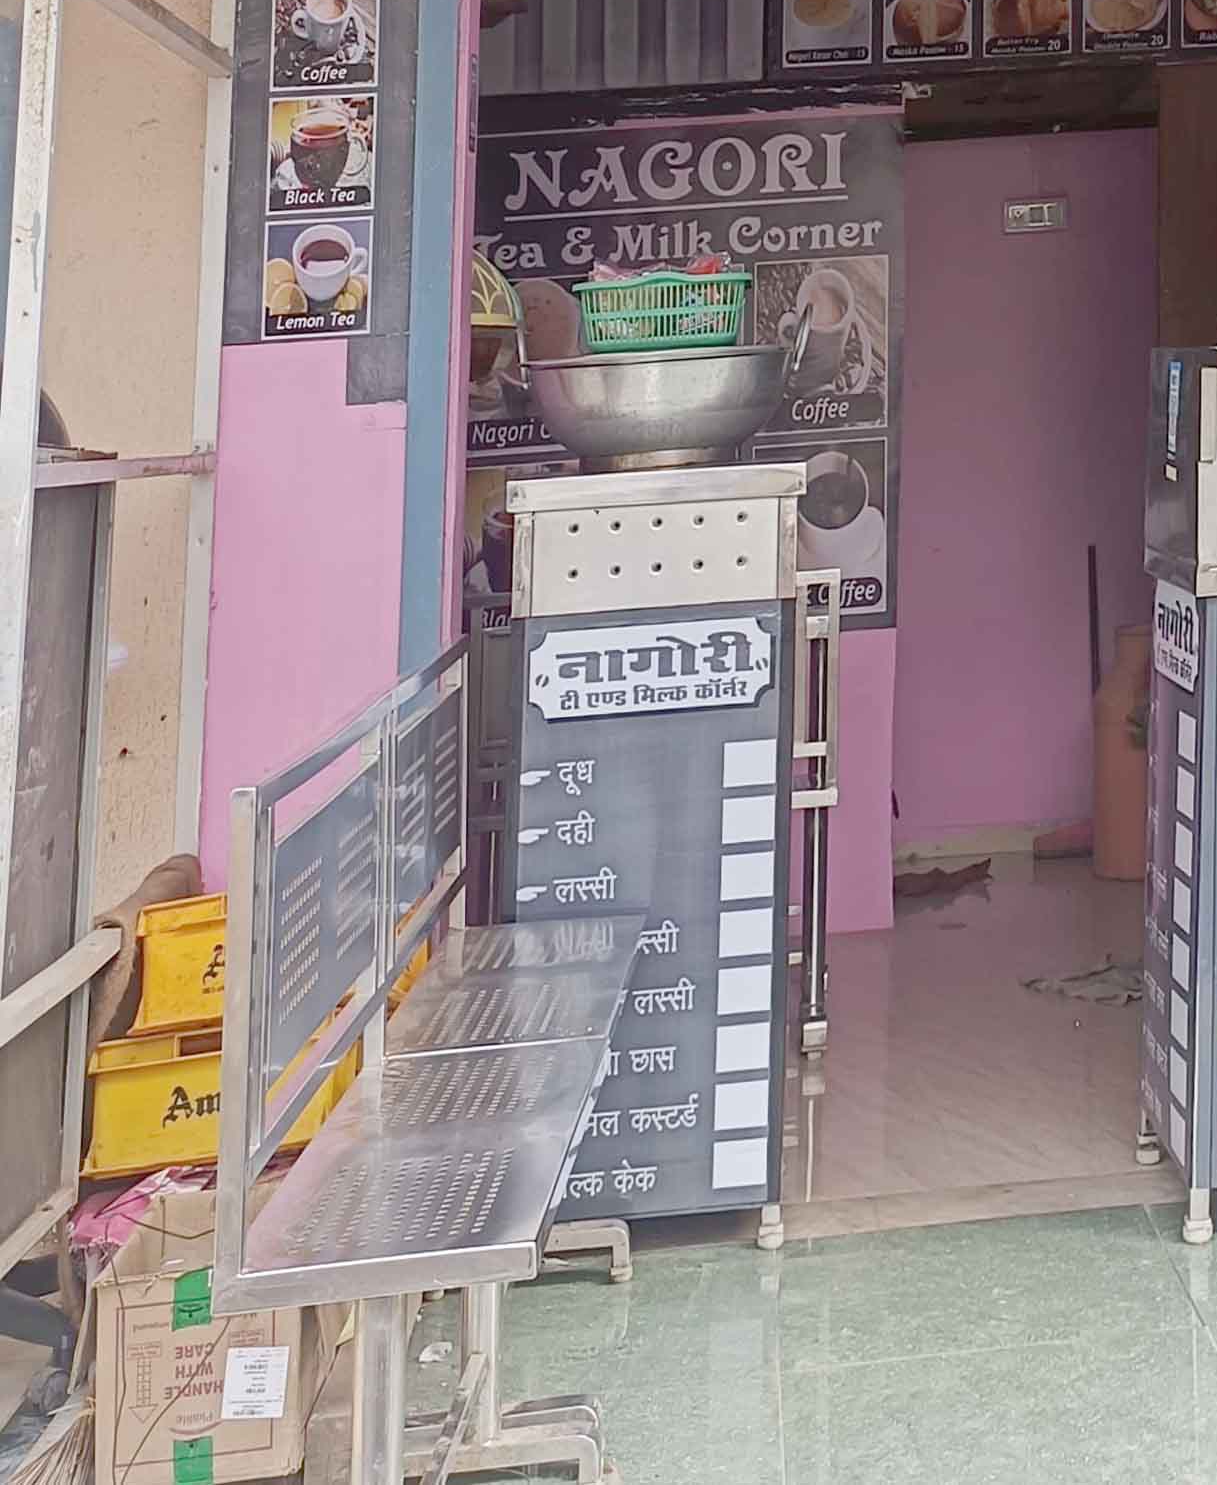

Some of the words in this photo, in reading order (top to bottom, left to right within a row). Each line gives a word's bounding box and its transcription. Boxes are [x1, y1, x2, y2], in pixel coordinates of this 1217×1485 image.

[1046, 38, 1061, 51] 20
[1150, 33, 1164, 46] 20
[300, 65, 348, 84] Coffee
[504, 131, 849, 211] NAGORI
[284, 188, 325, 205] Black
[330, 187, 356, 202] Tea
[473, 233, 547, 271] Tea
[560, 226, 595, 265] &
[609, 220, 714, 263] Milk
[728, 215, 883, 254] Corner
[276, 314, 325, 331] Lemon
[330, 311, 356, 327] Tea
[791, 398, 850, 424] Coffee
[471, 418, 535, 449] Nagori
[817, 580, 877, 607] Cffee
[555, 631, 754, 684] नागोरी
[560, 690, 579, 711] टी
[586, 690, 627, 708] एण्ड
[633, 684, 688, 705] मिल्क
[694, 677, 748, 700] कॉर्नर
[557, 757, 596, 796] दूध
[555, 810, 596, 846] दही
[553, 866, 617, 904] लस्सी
[632, 977, 697, 1015] लस्सी
[629, 1046, 677, 1073] छास
[629, 1092, 699, 1132] कस्टर्ड
[611, 1159, 658, 1193] केक
[175, 1342, 214, 1360] CARE
